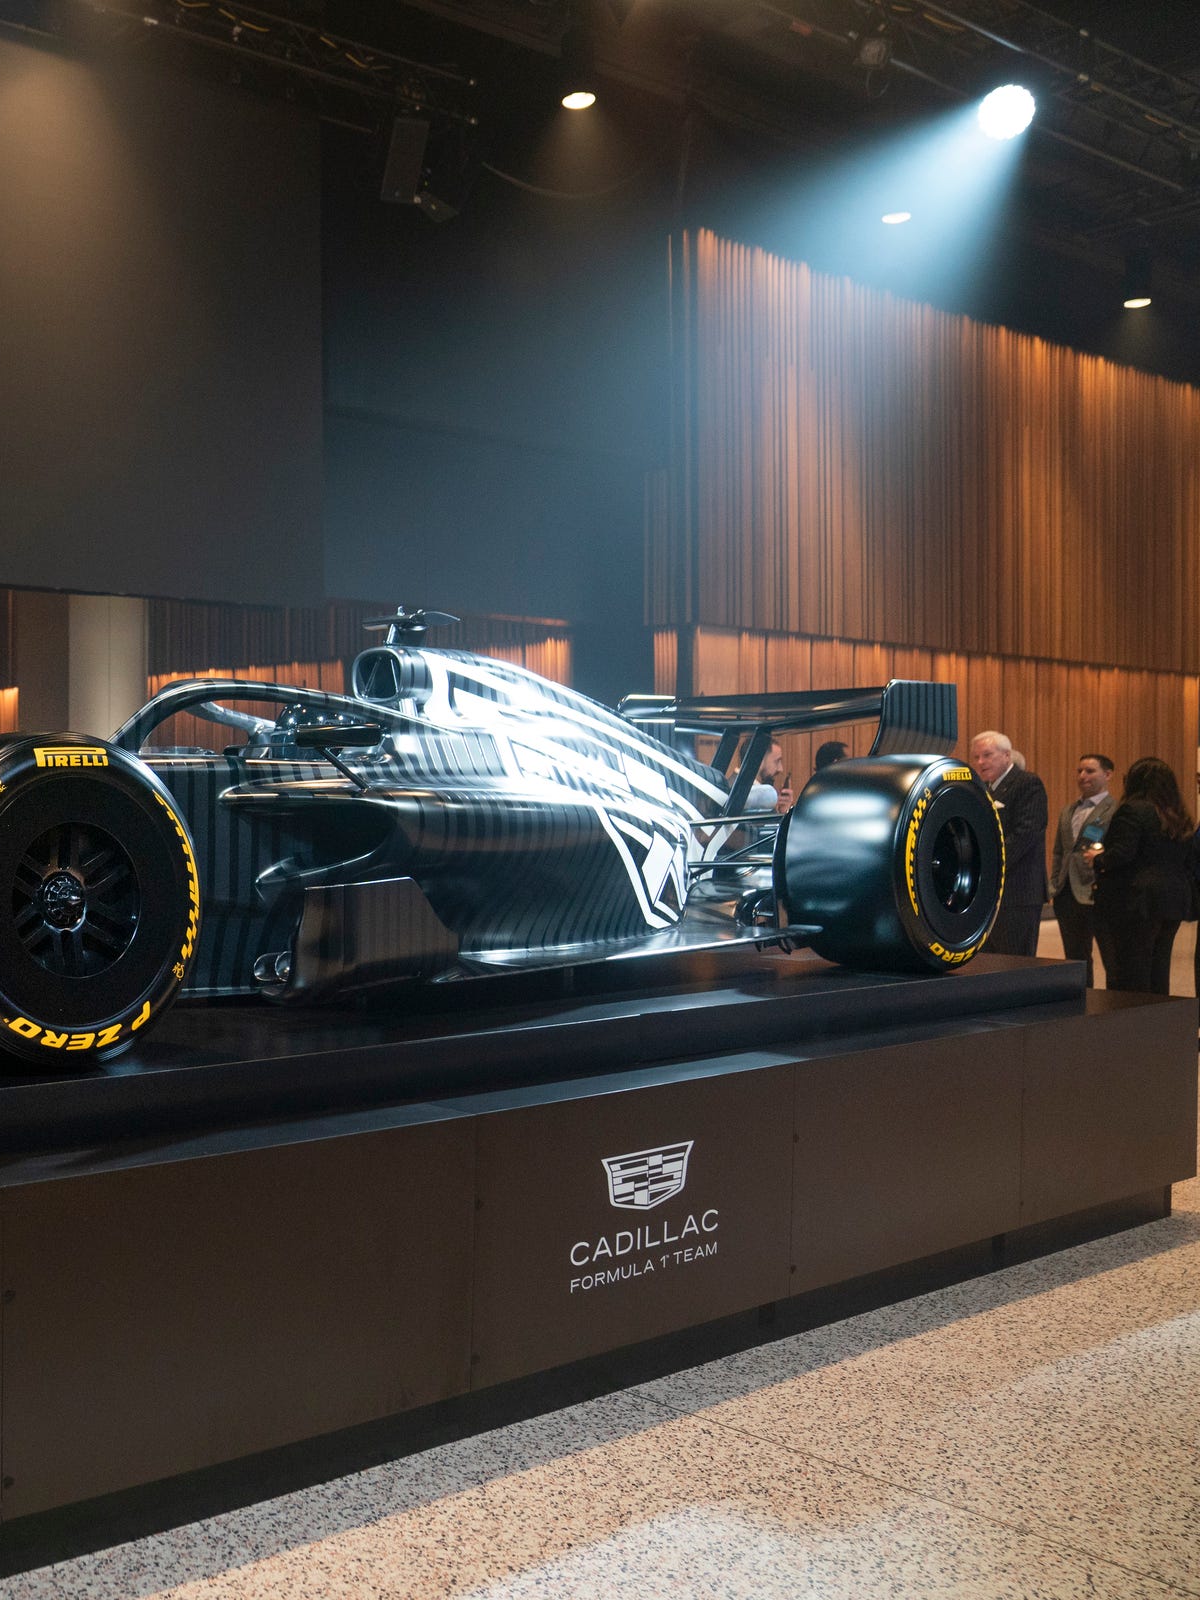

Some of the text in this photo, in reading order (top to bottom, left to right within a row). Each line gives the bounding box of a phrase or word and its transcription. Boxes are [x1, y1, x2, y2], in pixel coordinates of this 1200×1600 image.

[33, 747, 109, 768] PIRELLI
[929, 942, 976, 963] ZERO
[8, 1000, 150, 1051] P ZERO
[570, 1209, 719, 1266] CADILLAC
[570, 1259, 655, 1293] FORMULA
[673, 1241, 718, 1265] TEAM
